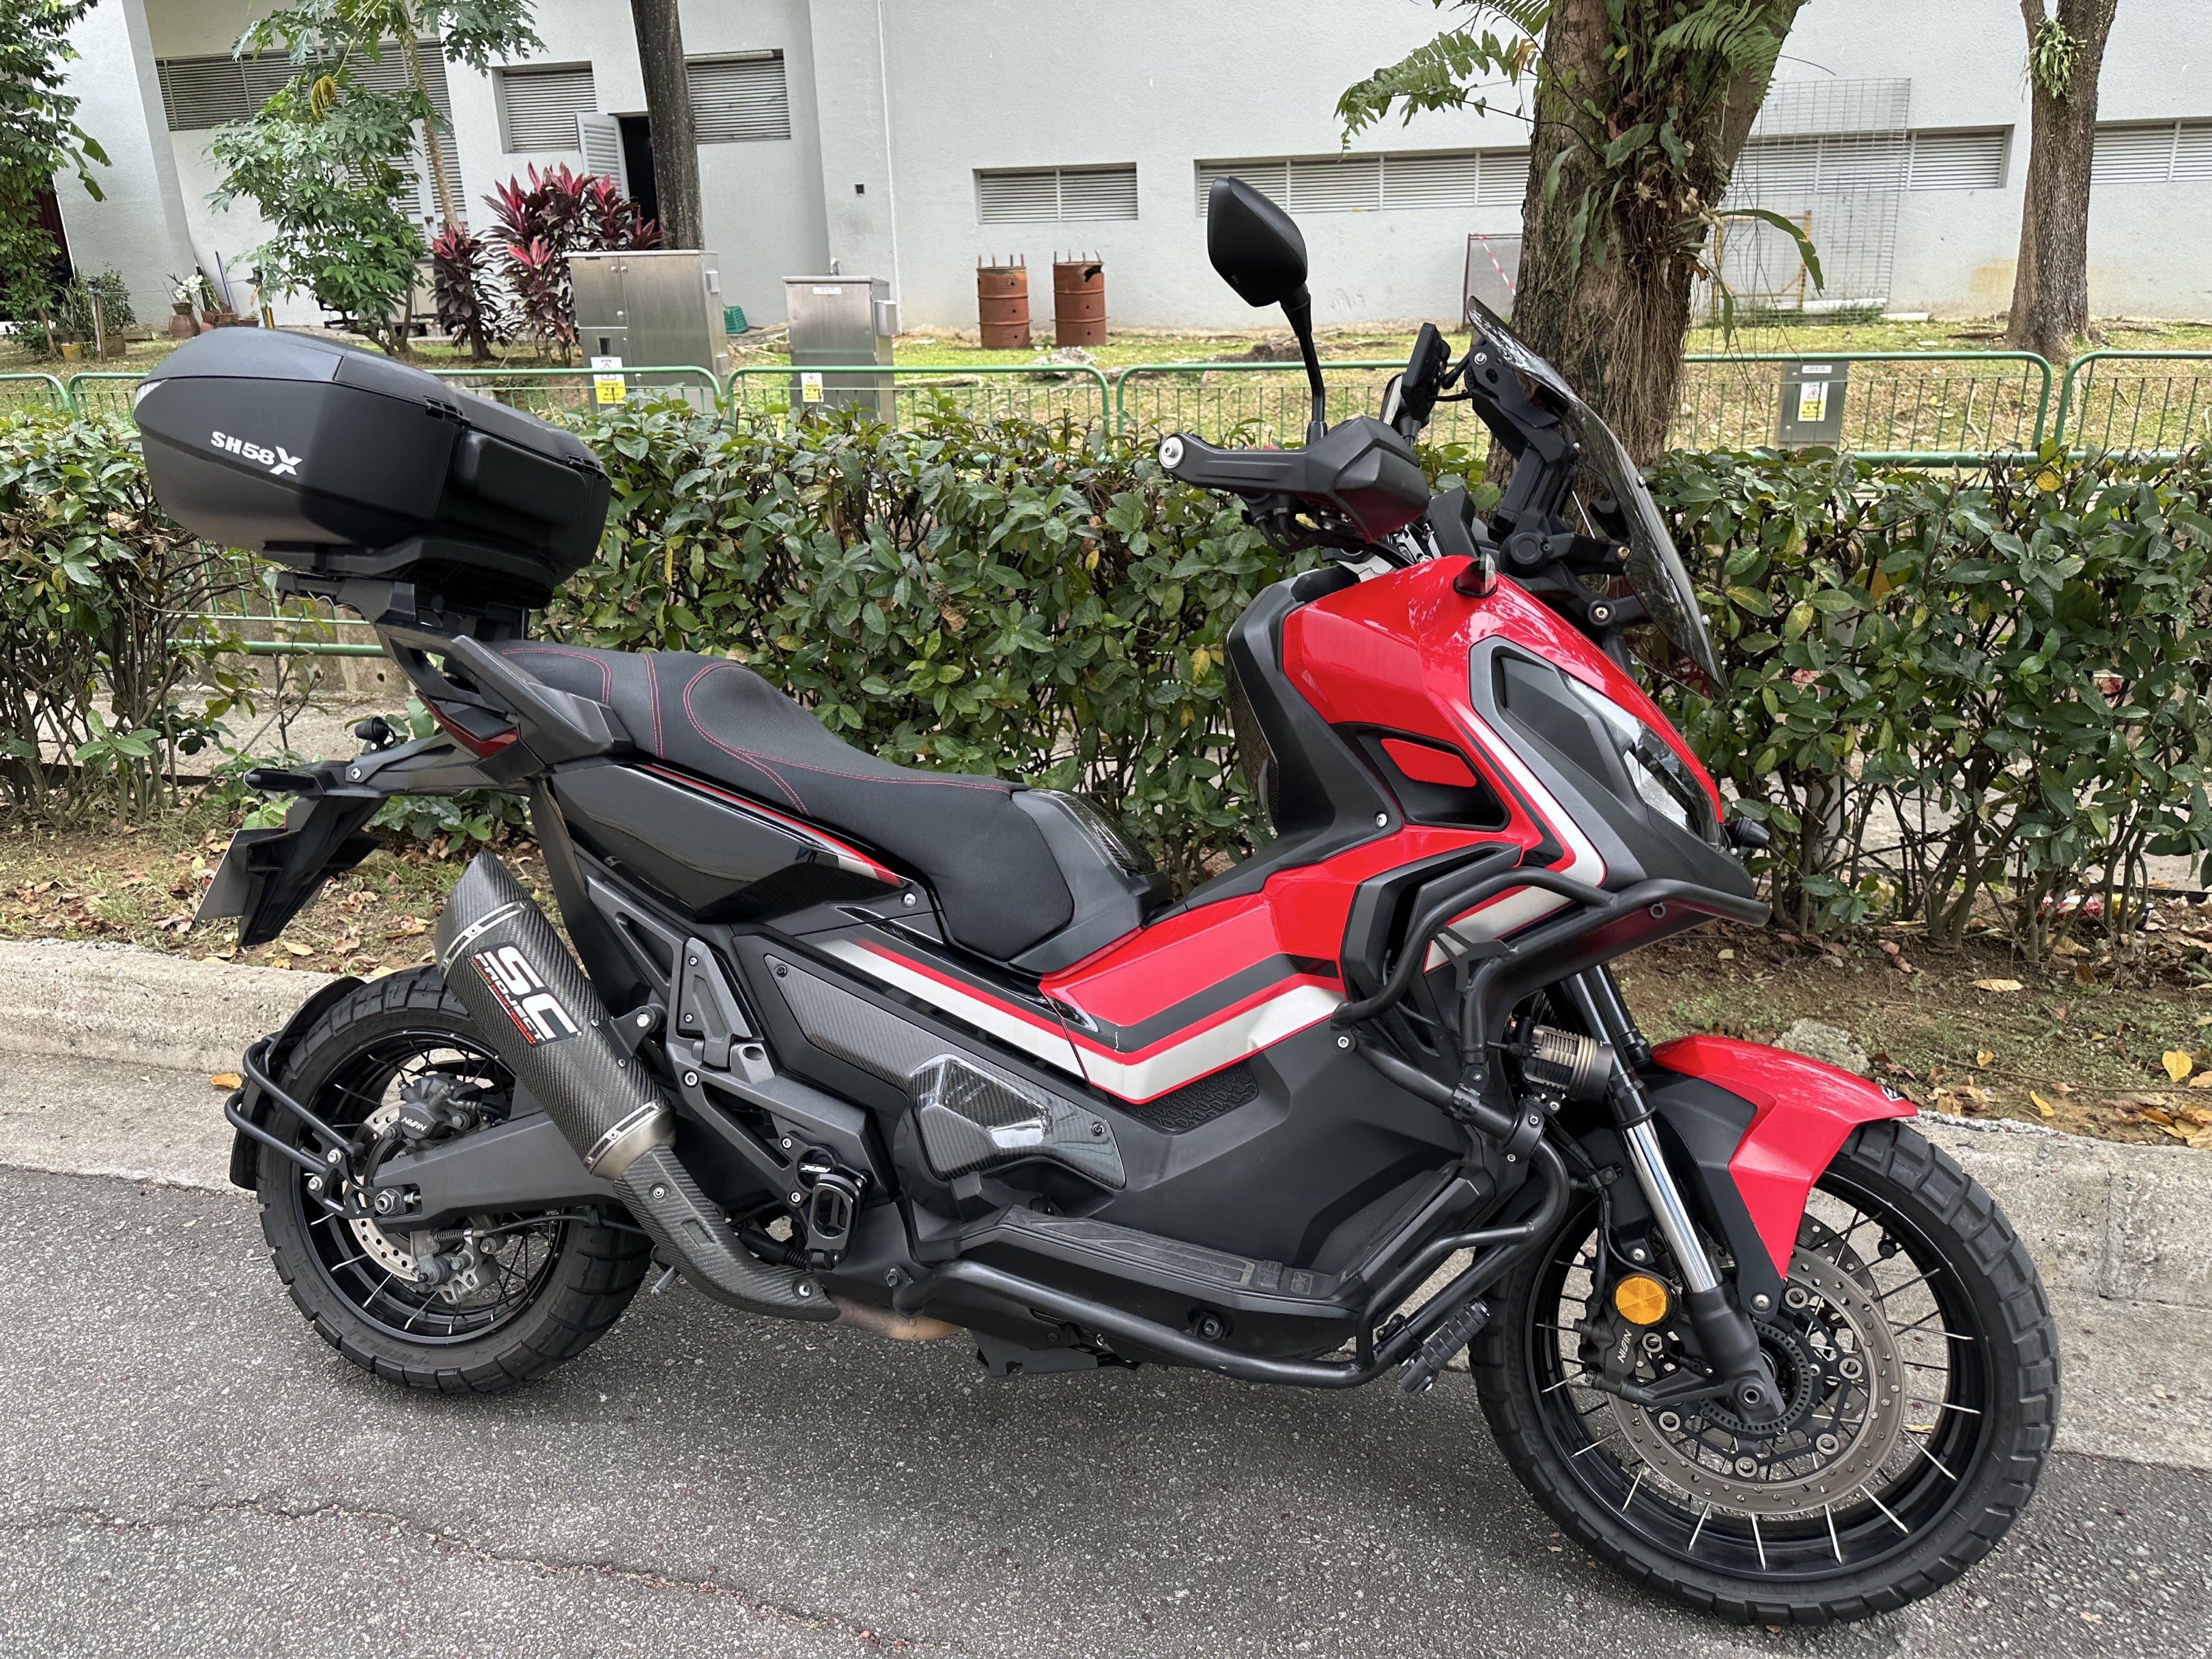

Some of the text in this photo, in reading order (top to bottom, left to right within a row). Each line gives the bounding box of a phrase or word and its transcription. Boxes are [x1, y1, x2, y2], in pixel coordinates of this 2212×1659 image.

[210, 431, 302, 475] SH58X
[474, 953, 545, 1041] PROJECT
[483, 946, 579, 1040] SC
[490, 984, 511, 1008] EXHAUST
[509, 1008, 537, 1043] TECHNOLOGY
